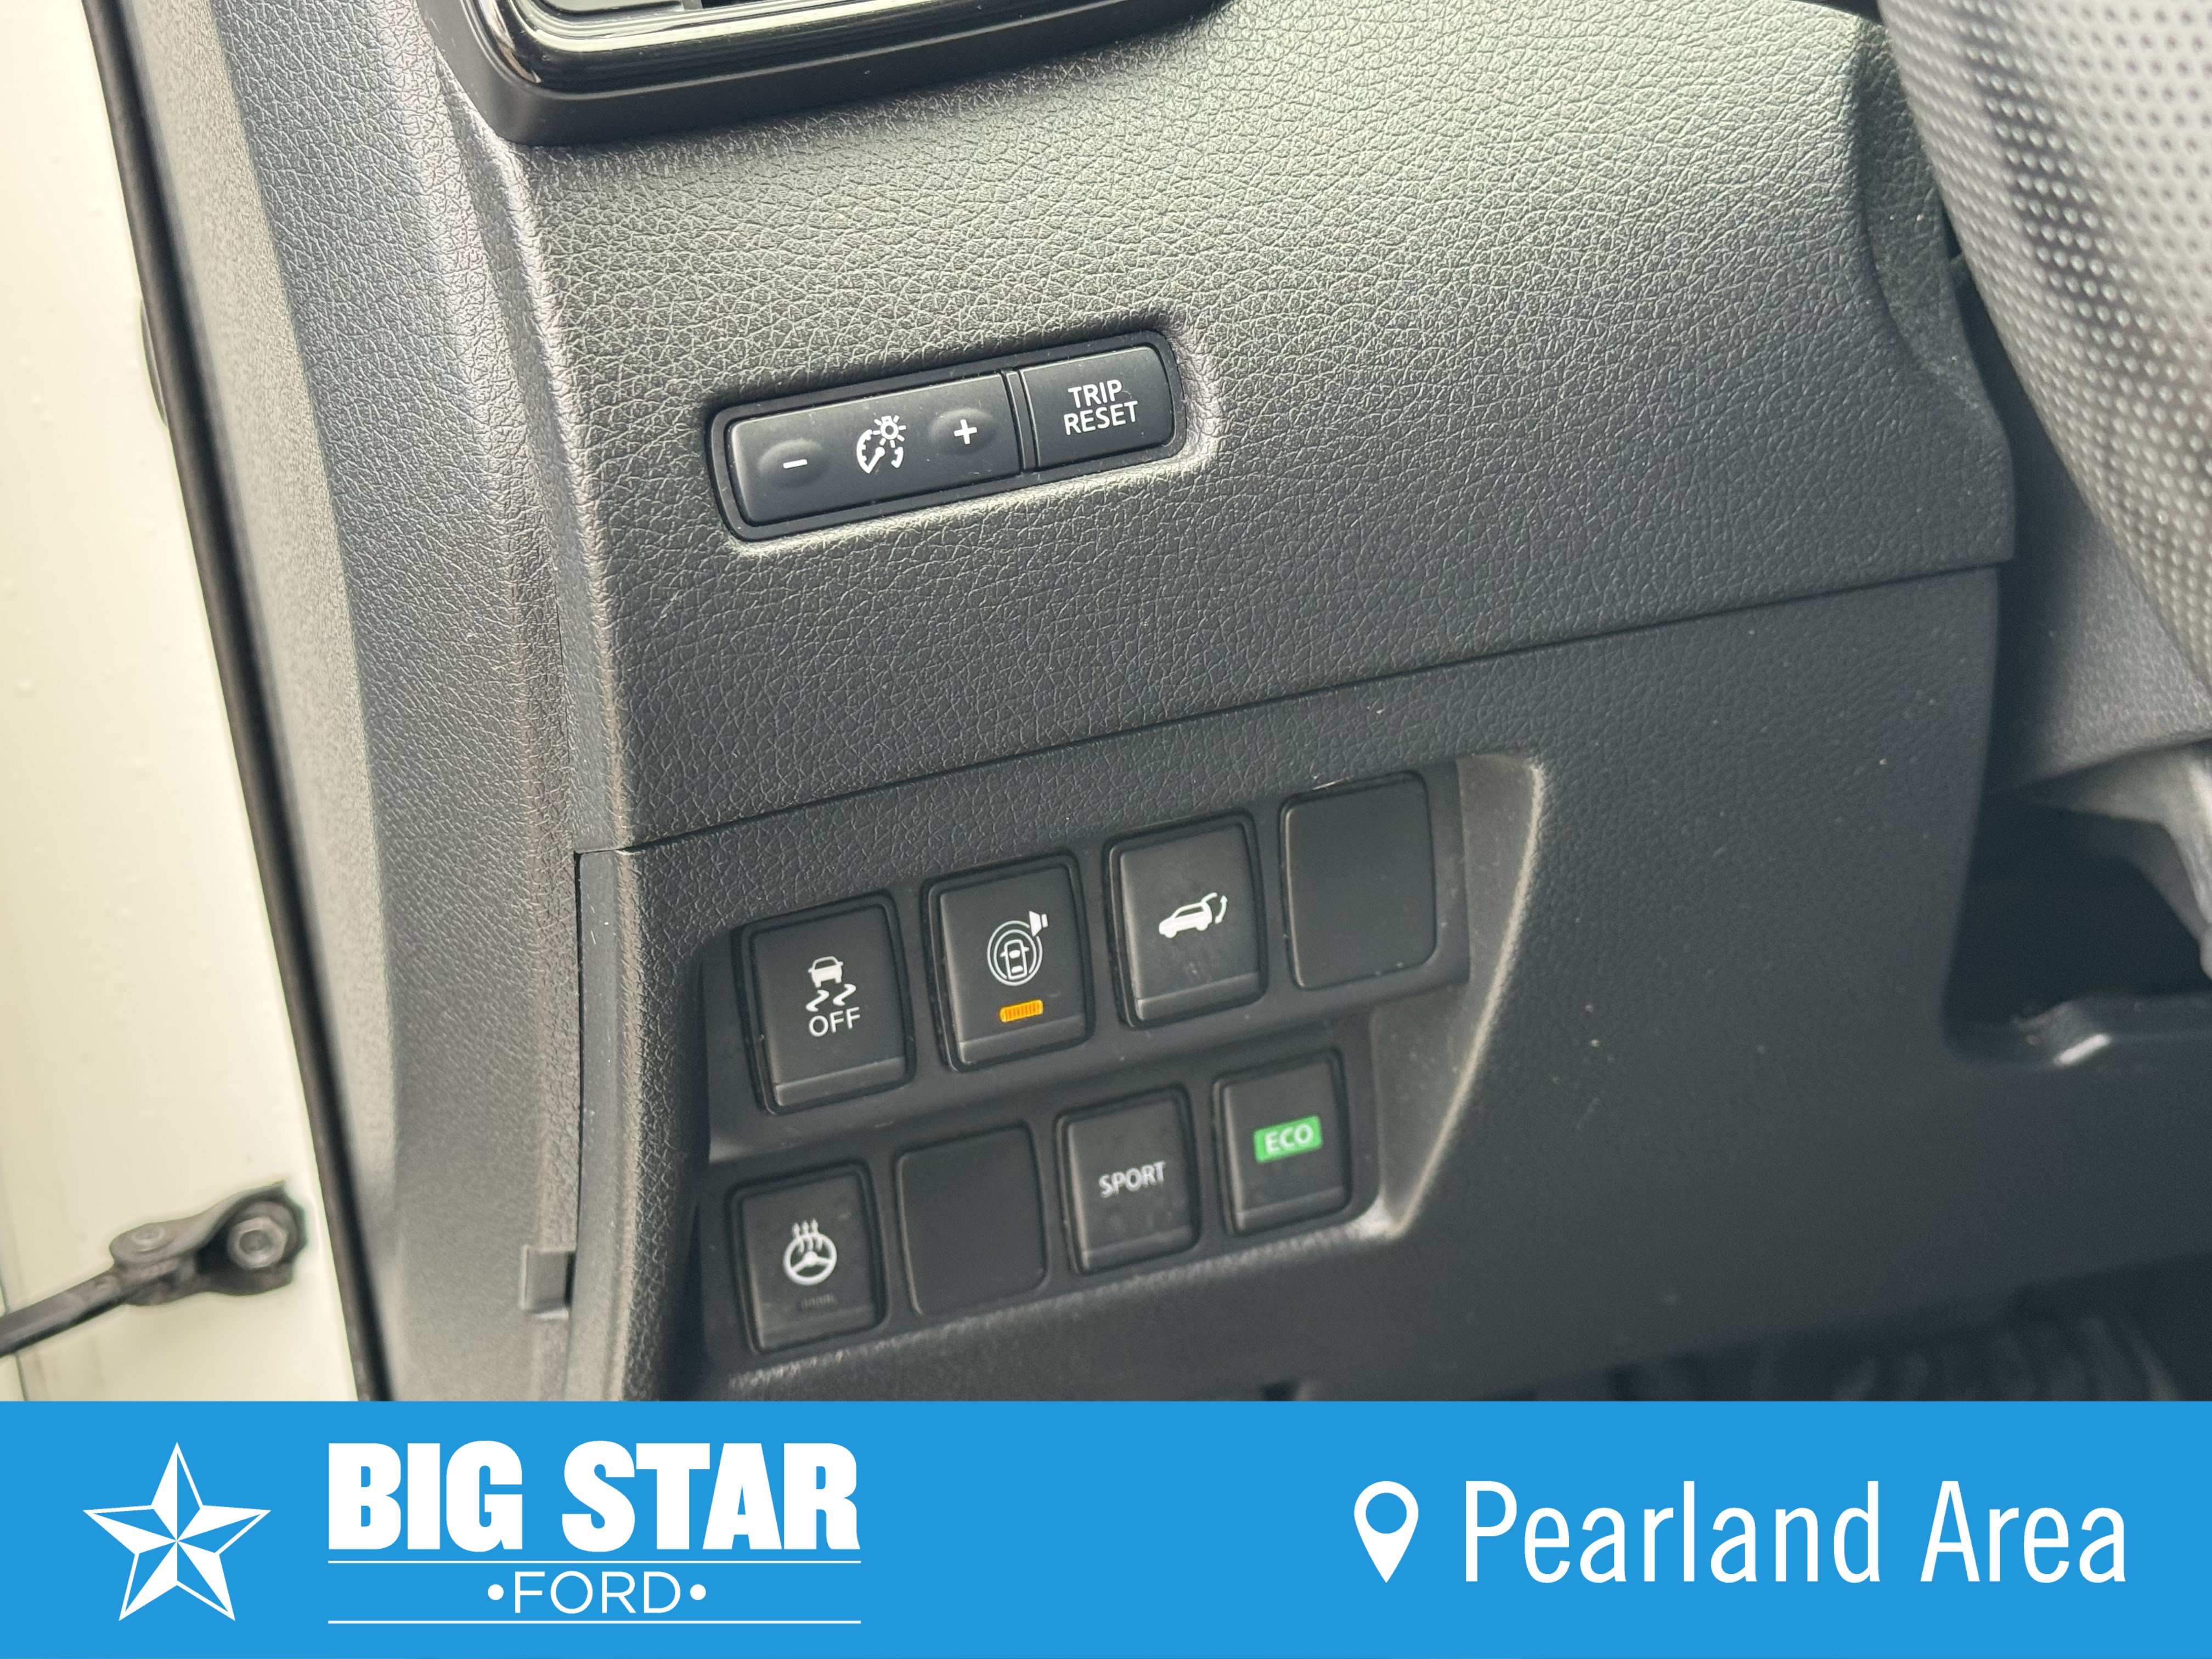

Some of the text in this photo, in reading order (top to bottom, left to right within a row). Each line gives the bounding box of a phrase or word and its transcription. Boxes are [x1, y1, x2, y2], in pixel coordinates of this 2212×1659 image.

[1067, 379, 1122, 409] TRIP
[1063, 400, 1139, 436] RESET
[808, 1006, 861, 1037] OFF
[1263, 1123, 1314, 1155] ECO
[1098, 1159, 1167, 1198] SPORT
